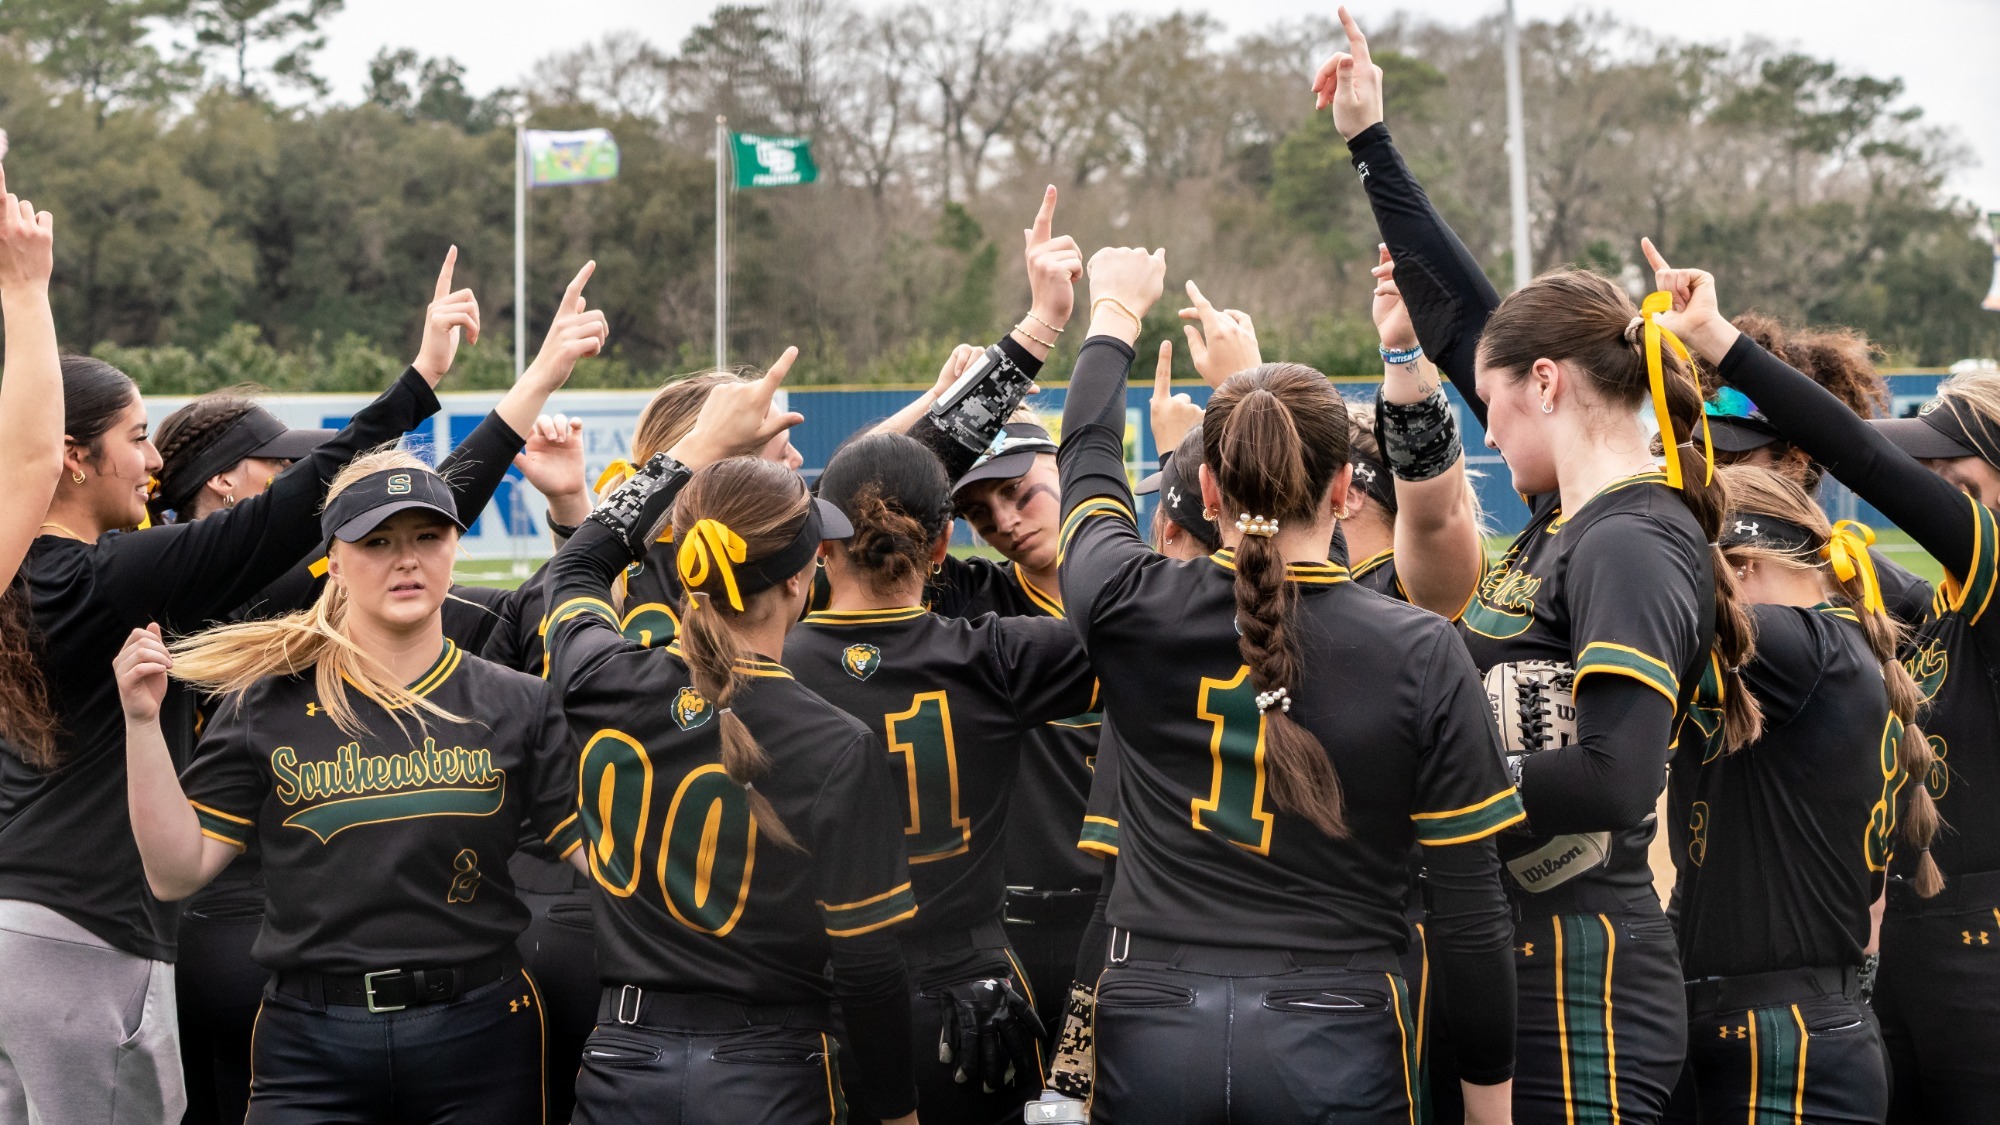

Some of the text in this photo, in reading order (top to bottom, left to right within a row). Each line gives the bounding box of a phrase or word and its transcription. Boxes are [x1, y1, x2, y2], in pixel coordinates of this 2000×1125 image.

[1389, 354, 1413, 363] AUTISM
[387, 473, 412, 495] S
[271, 736, 494, 806] Southeastern
[1190, 664, 1275, 857] 1
[577, 728, 758, 938] 00
[447, 848, 481, 903] 2
[1521, 845, 1584, 884] Wilson
